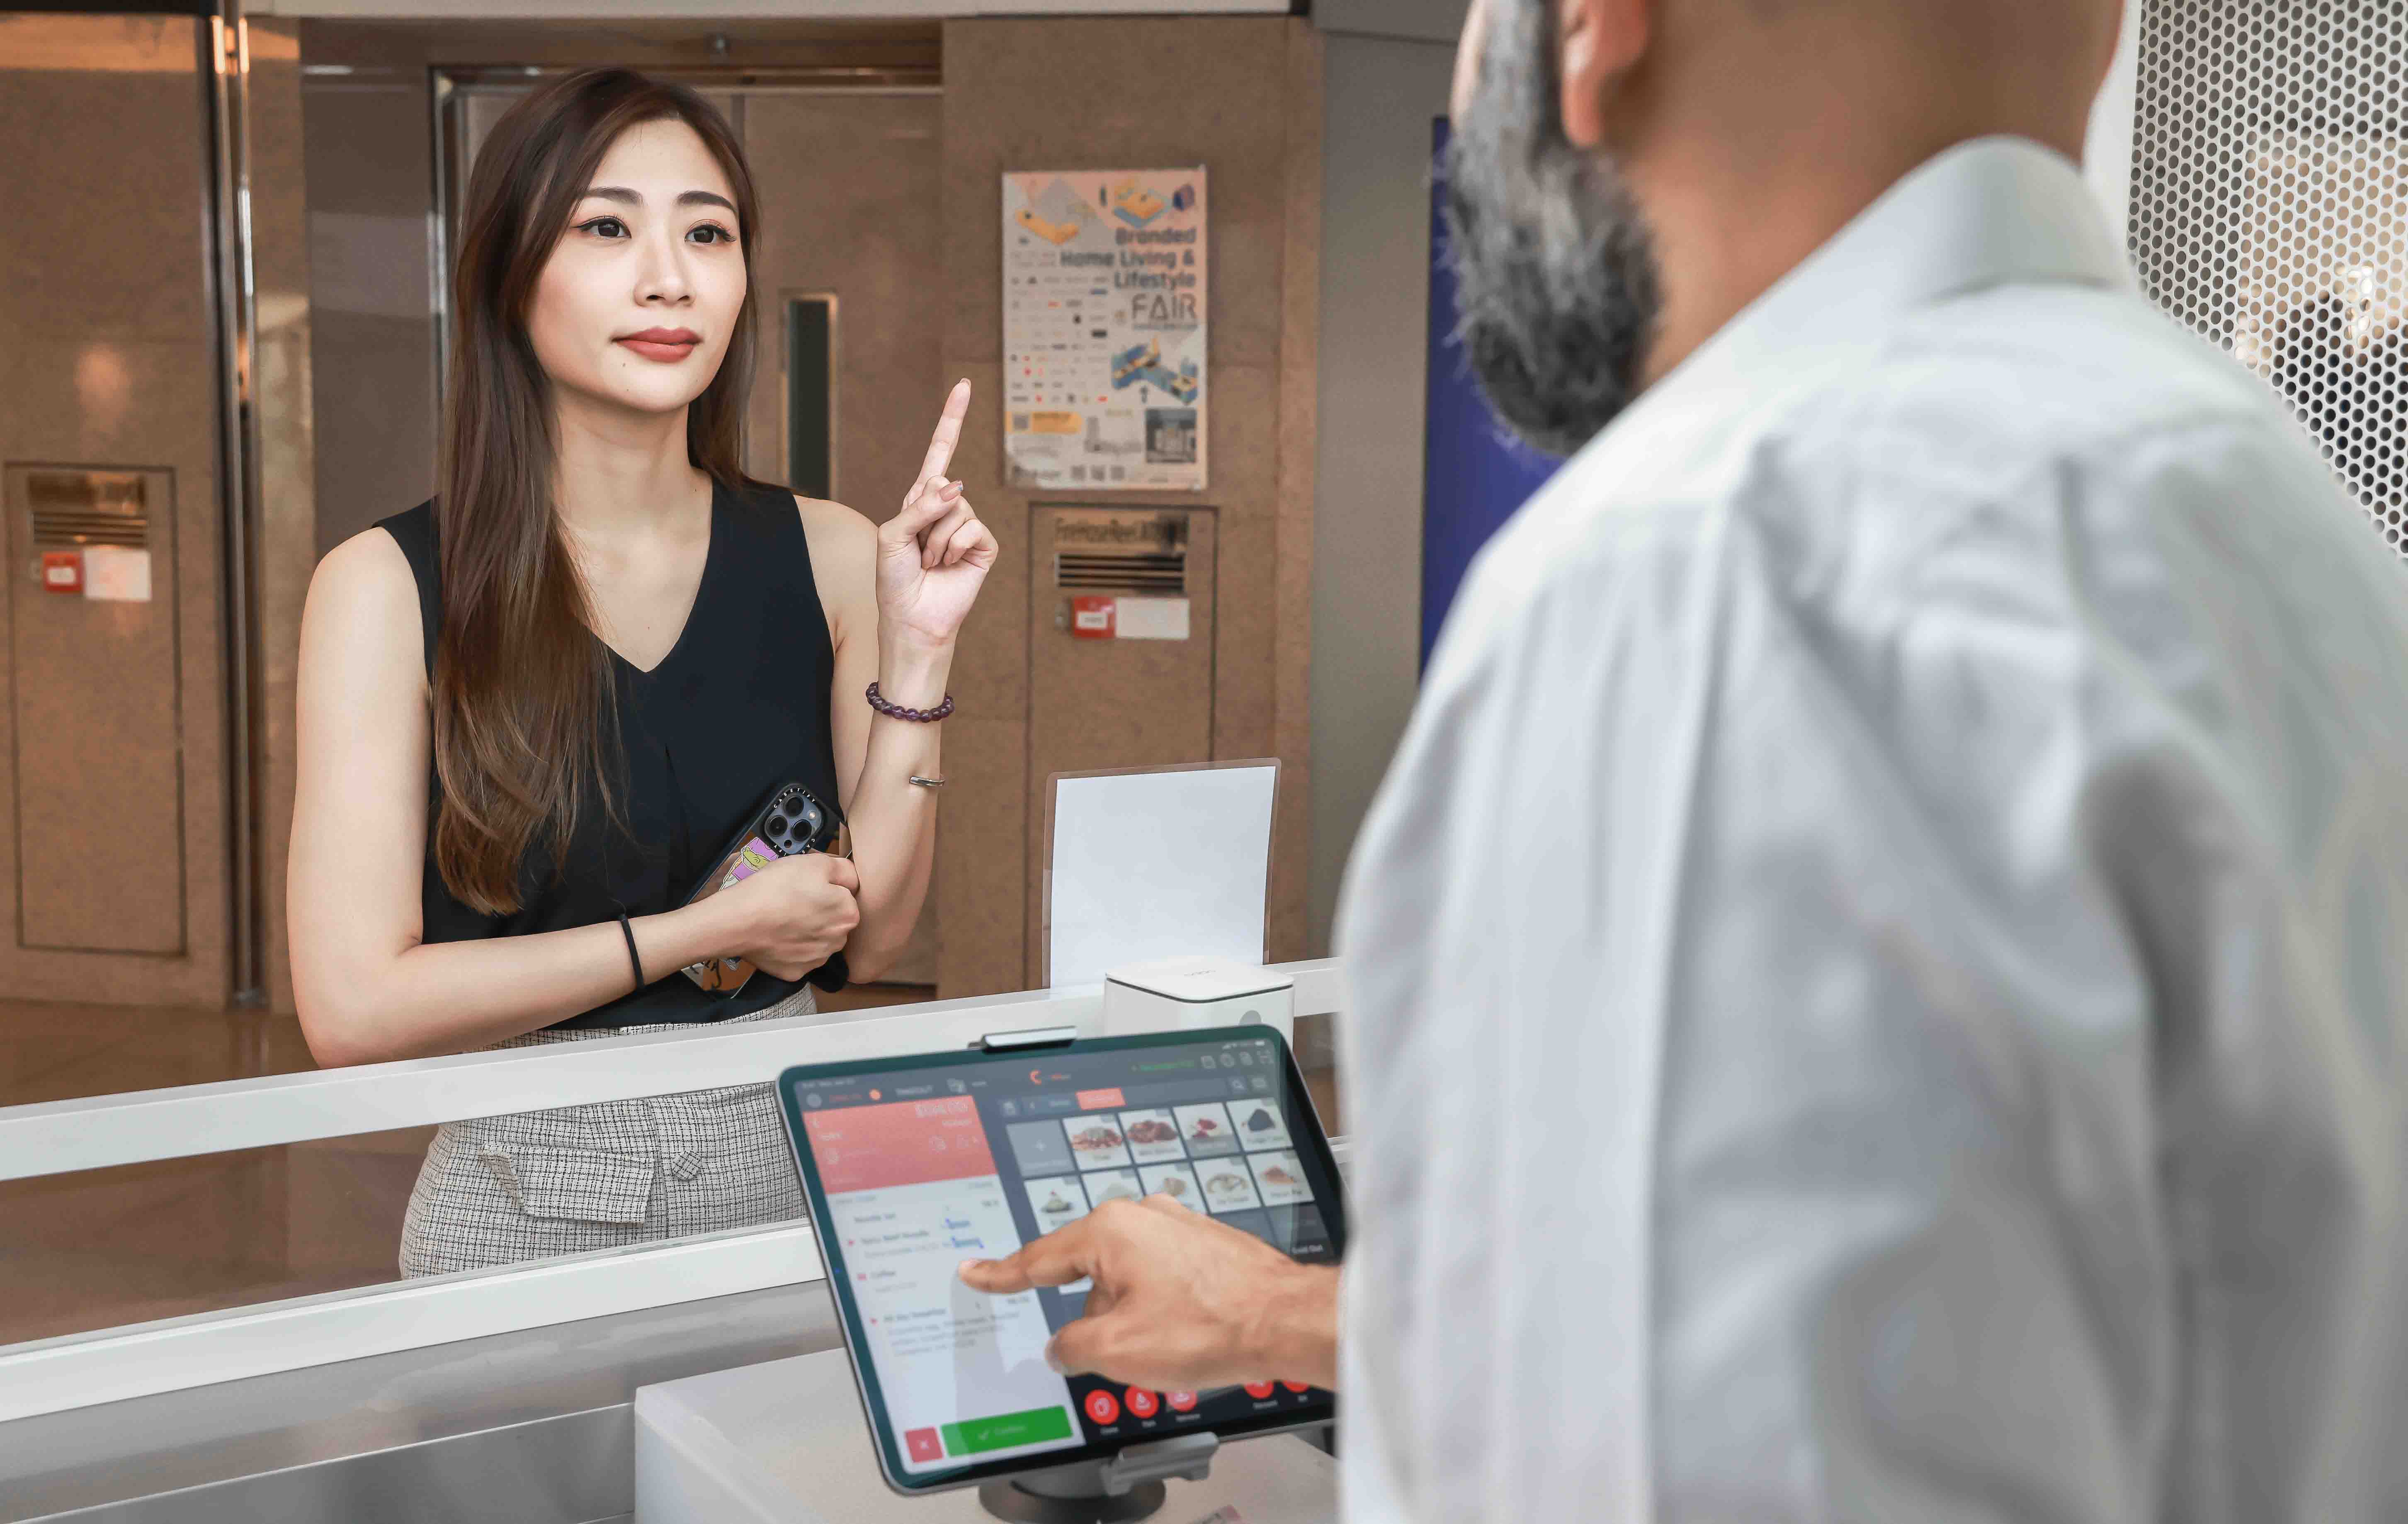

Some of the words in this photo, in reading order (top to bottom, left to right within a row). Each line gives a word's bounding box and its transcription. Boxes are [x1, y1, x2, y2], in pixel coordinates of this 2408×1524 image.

[1114, 228, 1197, 245] Branded
[1061, 251, 1115, 267] Home
[1120, 251, 1177, 269] Living
[1182, 250, 1195, 266] &
[1114, 272, 1196, 290] Lifestyle
[1132, 294, 1197, 320] FAIR
